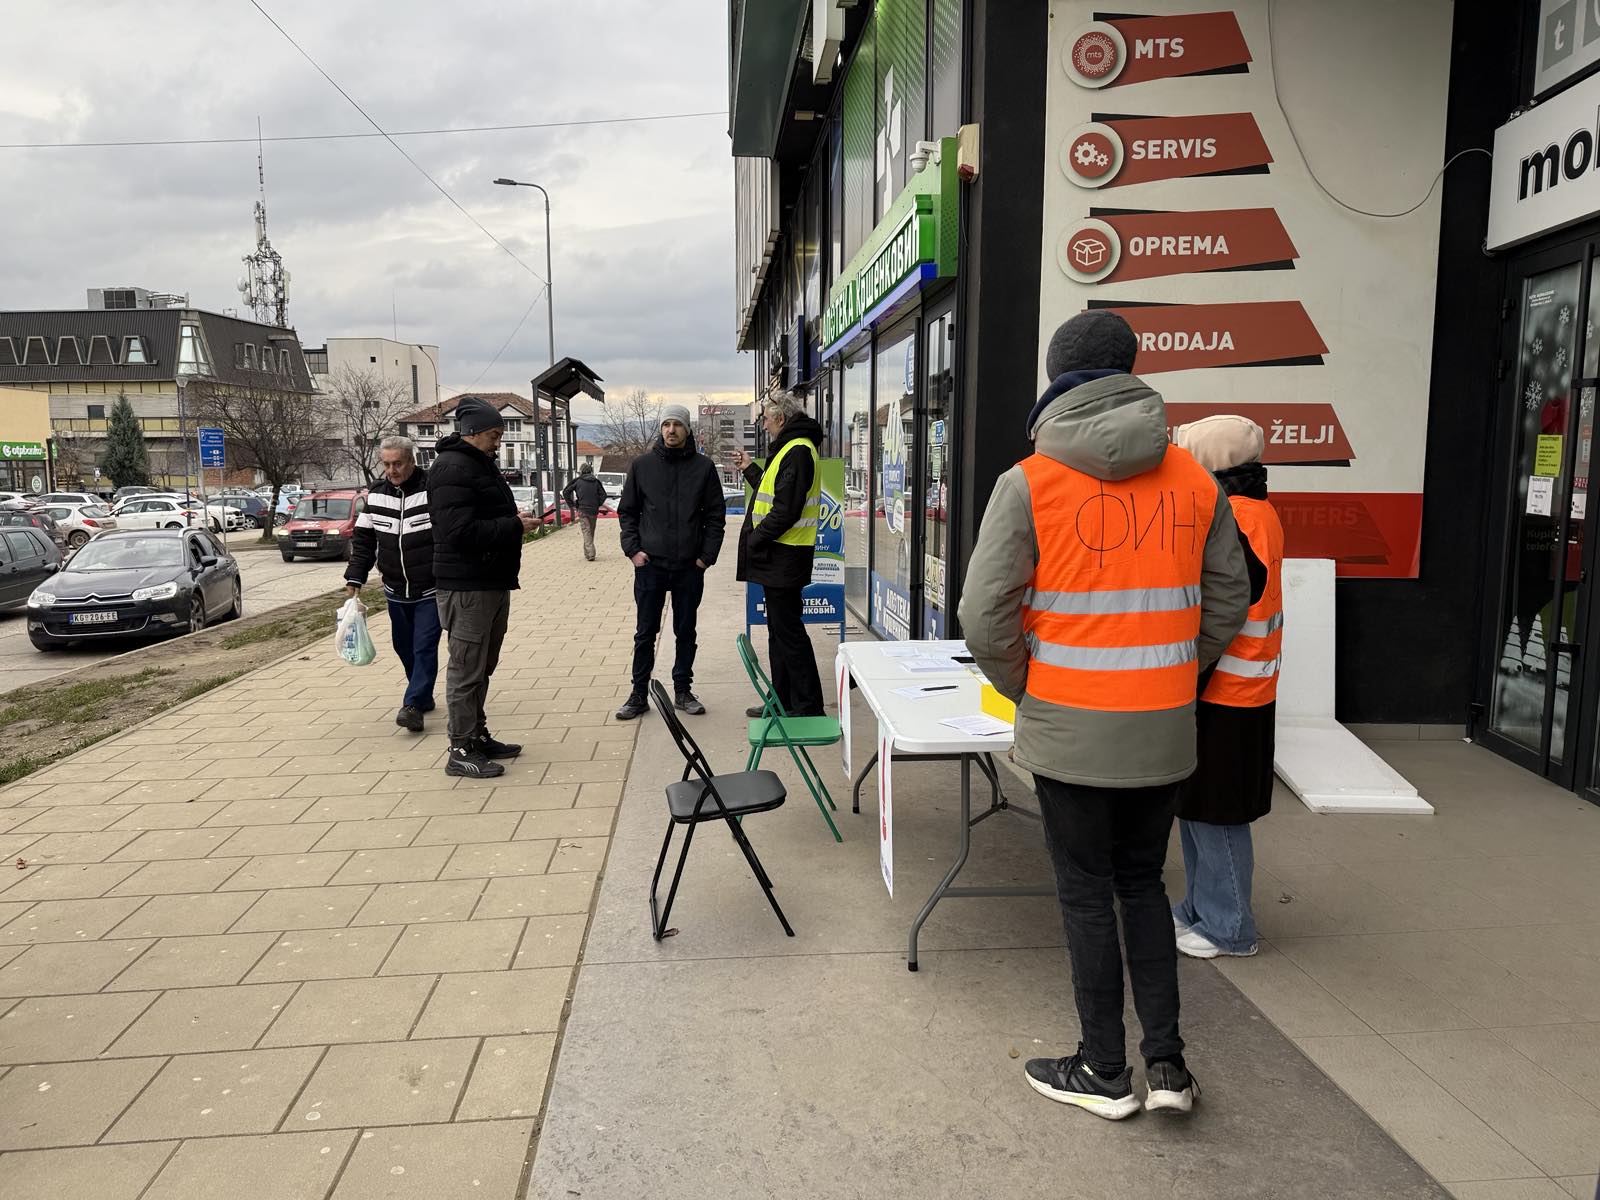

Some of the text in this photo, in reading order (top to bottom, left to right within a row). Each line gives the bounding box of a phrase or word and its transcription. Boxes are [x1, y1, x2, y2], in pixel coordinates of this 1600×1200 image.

[1134, 38, 1185, 59] MTS
[1131, 138, 1217, 160] SERVIS
[1129, 235, 1229, 257] OPREMA
[1269, 419, 1335, 444] ŽELJI
[1075, 481, 1196, 568] ФИН
[802, 598, 829, 606] ТЕКА
[74, 614, 84, 622] KG
